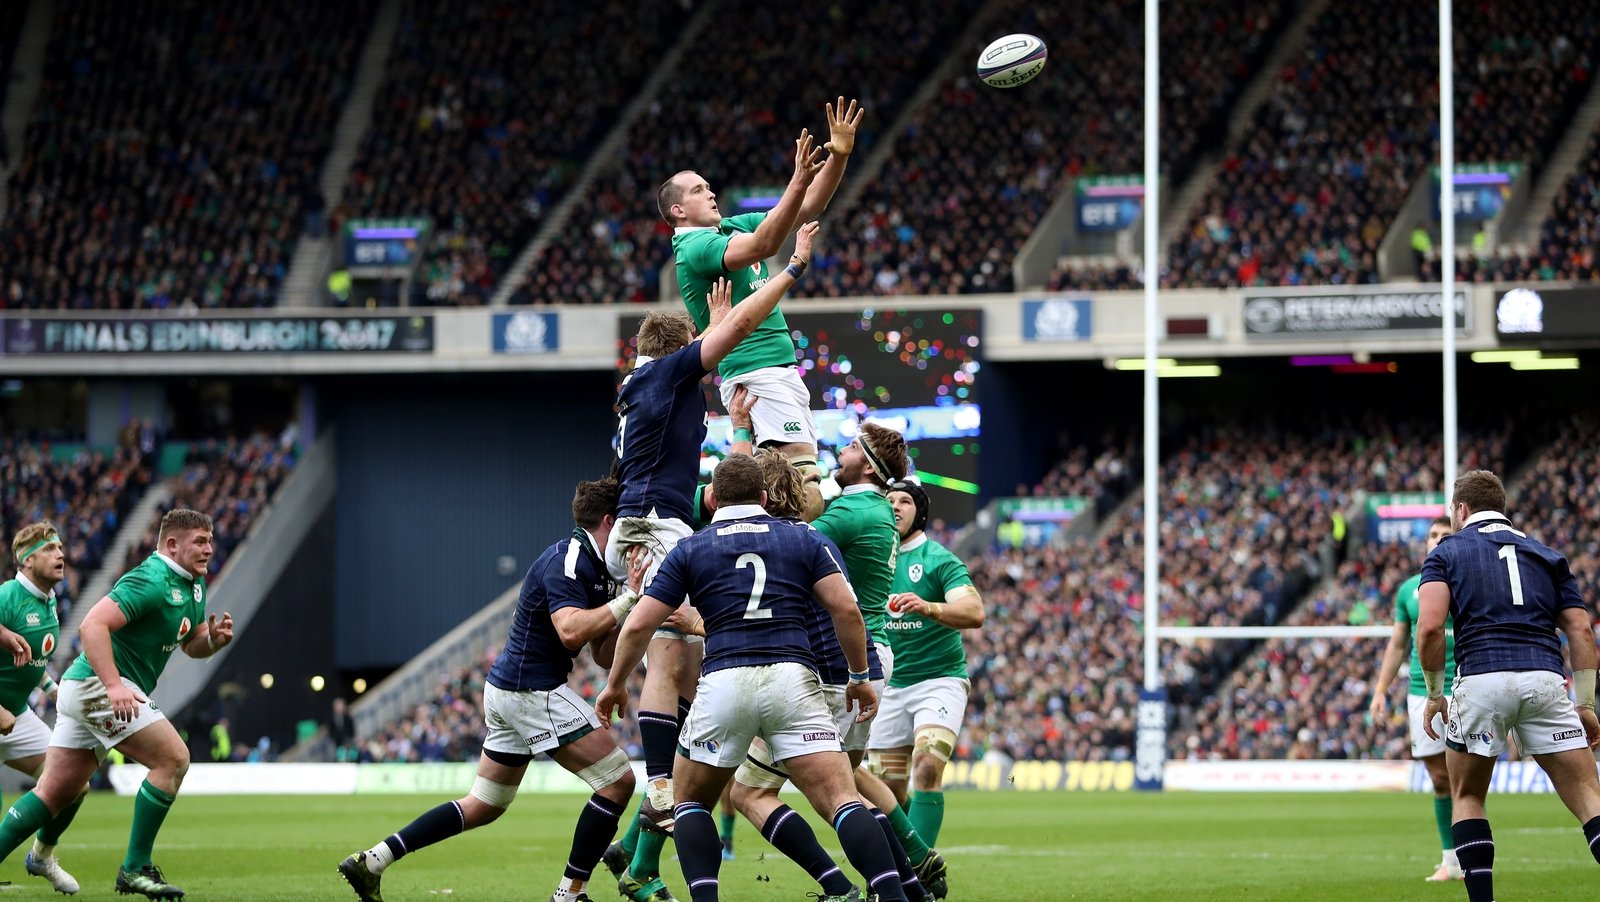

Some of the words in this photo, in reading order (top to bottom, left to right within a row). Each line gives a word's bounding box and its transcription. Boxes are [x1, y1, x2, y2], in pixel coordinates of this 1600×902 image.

[988, 62, 1042, 86] GILBERT
[45, 321, 149, 351] FINALS
[152, 320, 318, 351] EDINBURGH
[1498, 545, 1524, 605] 1
[735, 553, 773, 619] 2
[557, 716, 583, 730] macron
[532, 733, 550, 743] Mobile
[815, 733, 835, 741] Mobile
[1564, 730, 1583, 739] Mobile
[694, 740, 706, 748] BT
